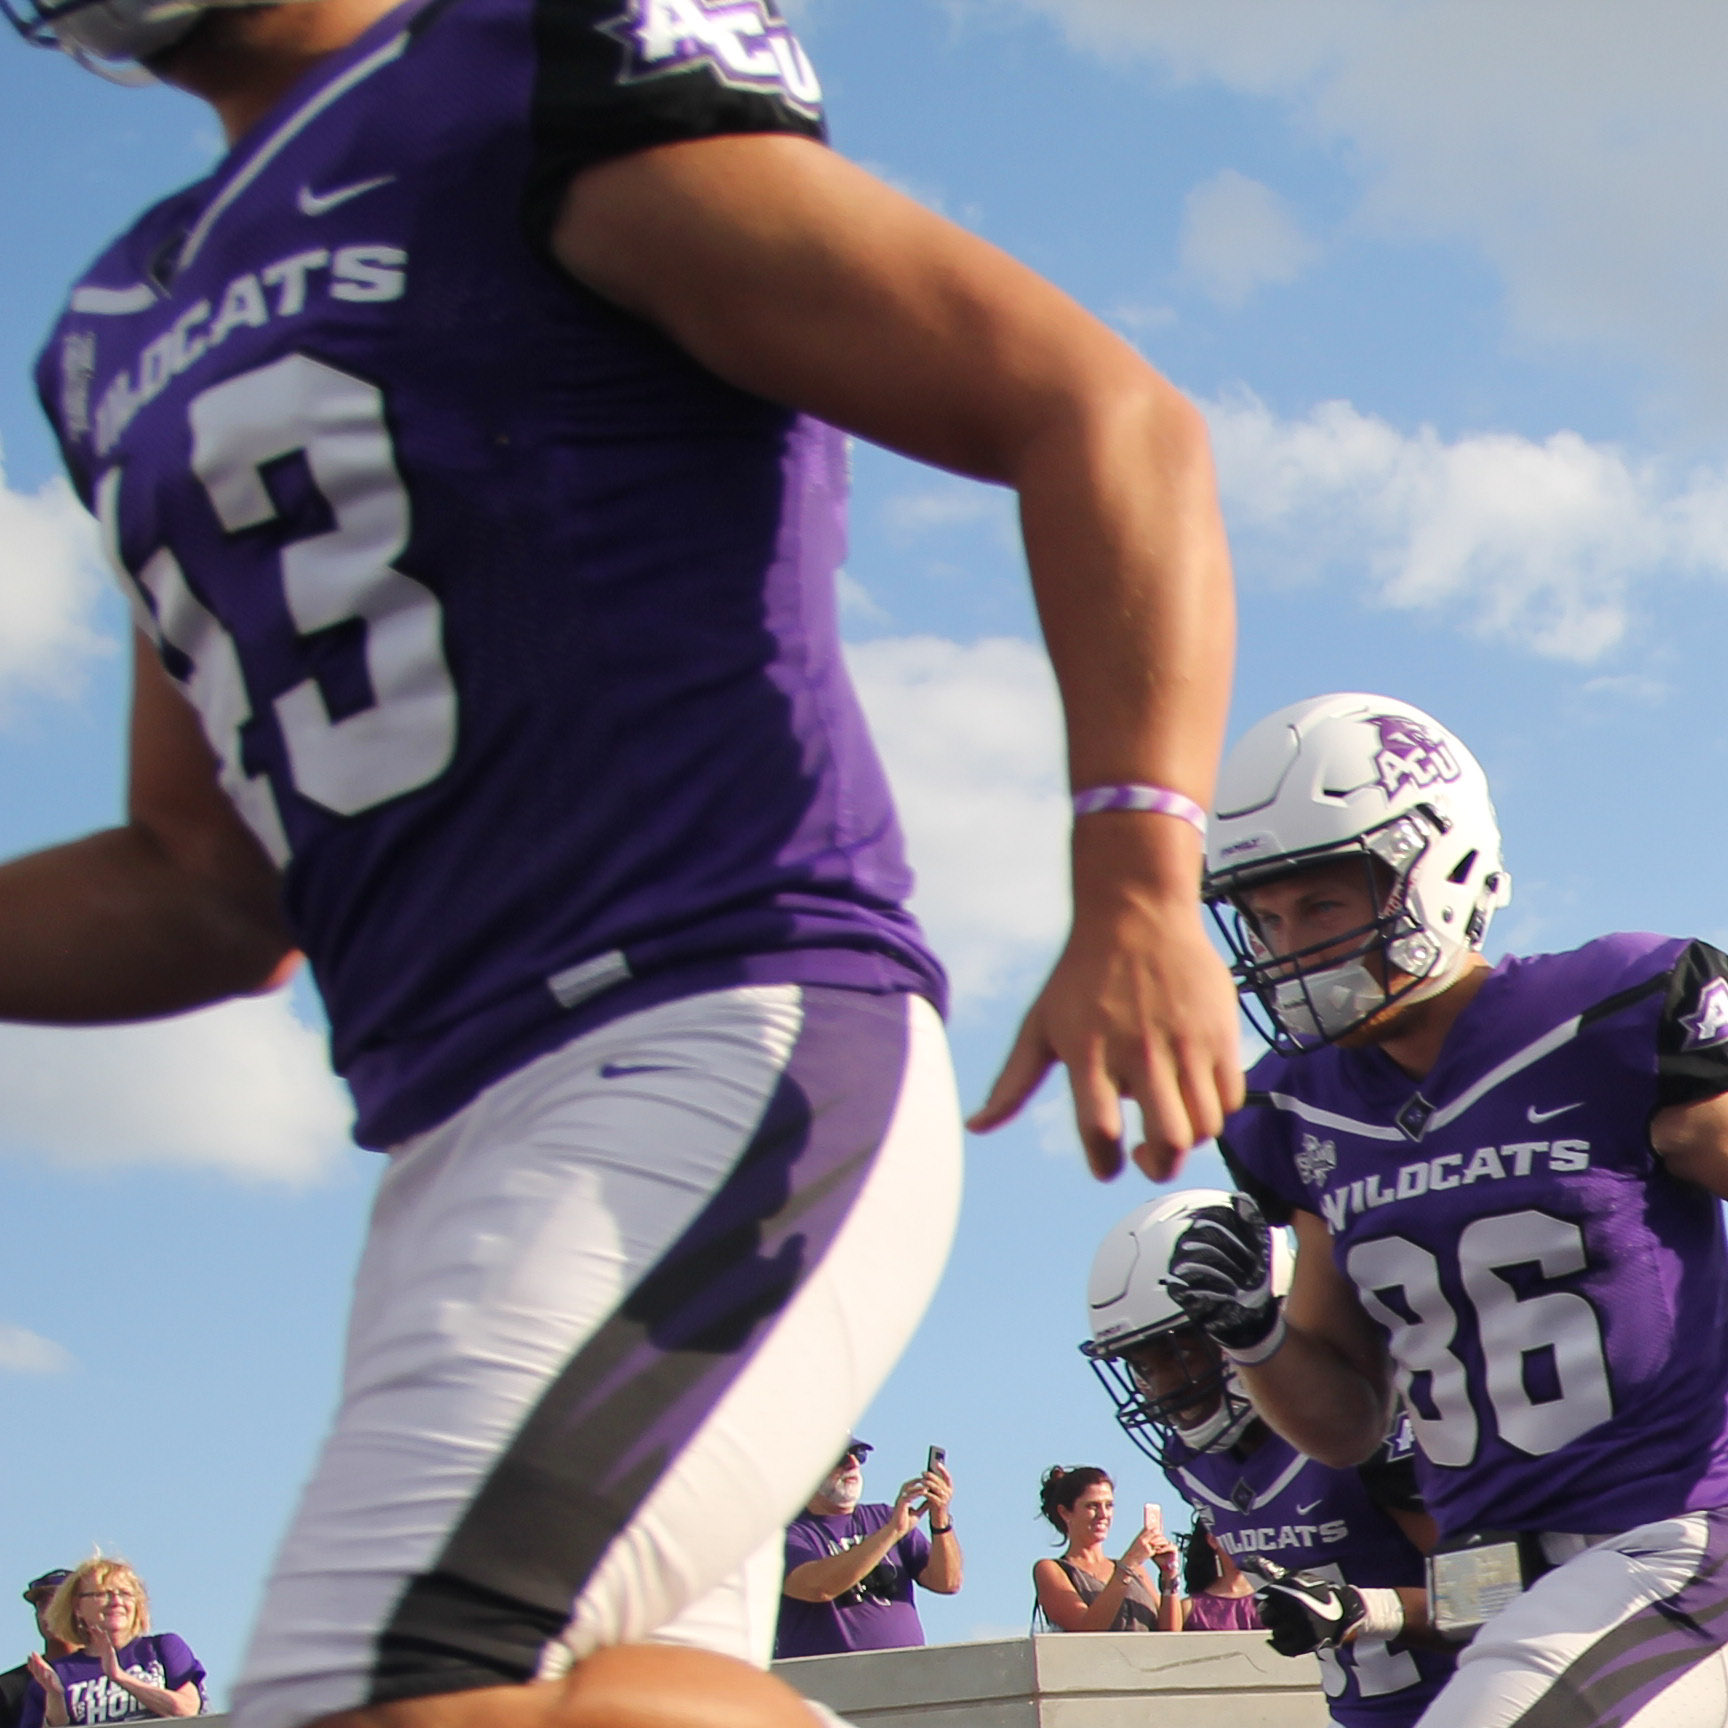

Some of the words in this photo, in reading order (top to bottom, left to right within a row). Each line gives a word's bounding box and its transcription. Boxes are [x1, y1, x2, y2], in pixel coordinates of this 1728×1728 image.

[1377, 742, 1460, 800] ACU
[1320, 1139, 1591, 1236] WILDCATS
[1346, 1208, 1614, 1467] 86
[86, 1692, 150, 1726] HO
